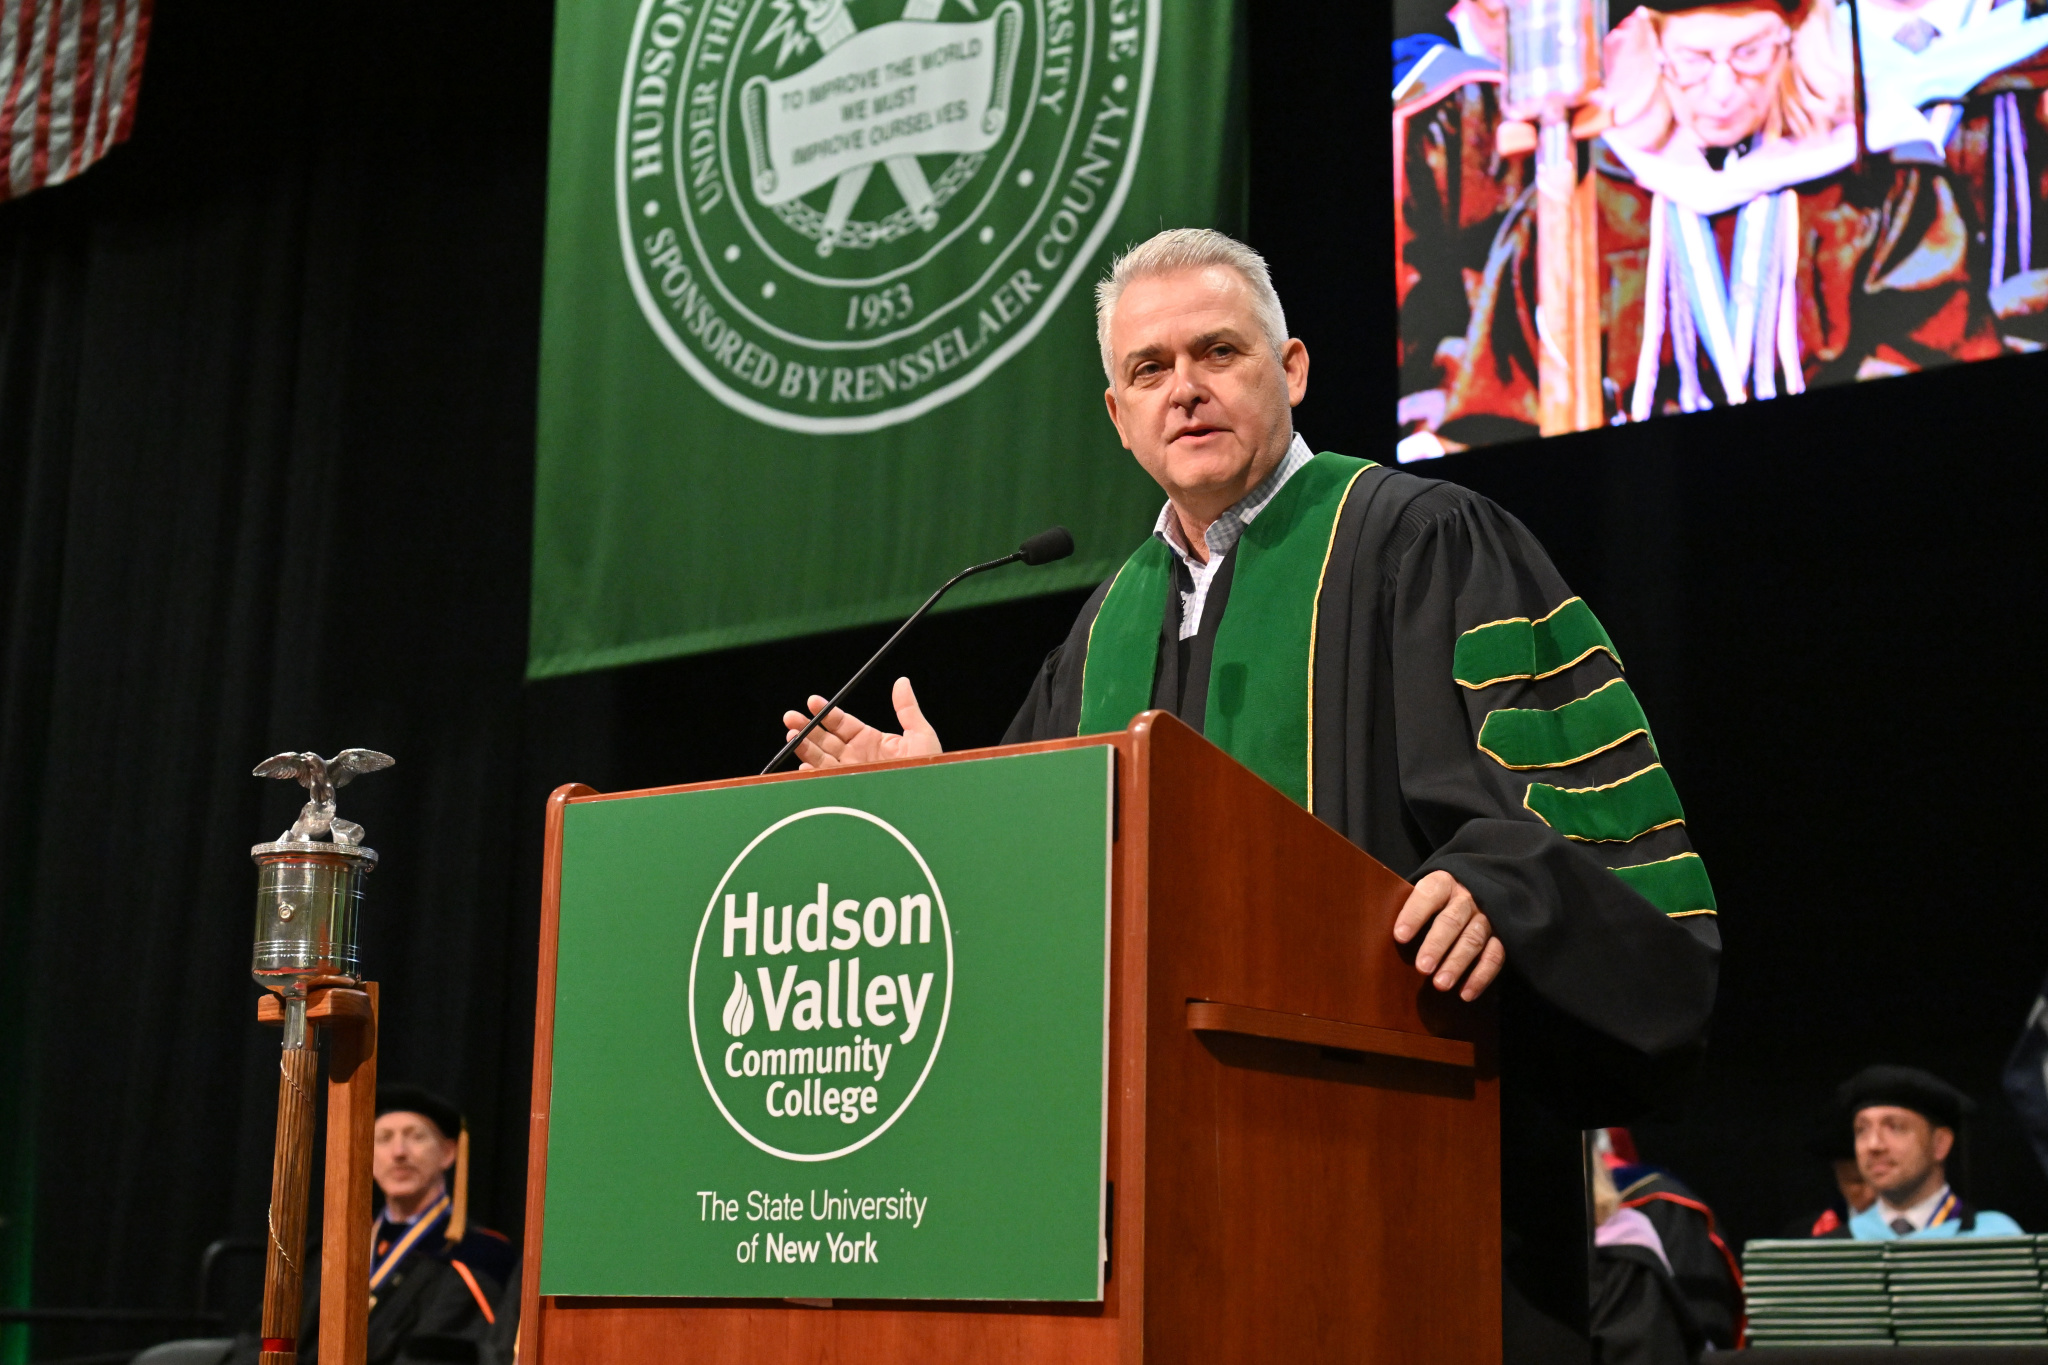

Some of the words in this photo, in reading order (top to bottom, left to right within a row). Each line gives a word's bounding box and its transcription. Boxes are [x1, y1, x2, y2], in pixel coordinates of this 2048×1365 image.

[781, 89, 803, 110] TO
[809, 68, 879, 104] IMPROVE
[885, 55, 916, 82] THE
[920, 37, 983, 71] WORLD
[842, 99, 867, 122] WE
[873, 84, 917, 114] MUST
[689, 79, 724, 215] UNDER
[793, 128, 863, 165] IMPROVE
[869, 99, 968, 146] OURSELVES
[643, 227, 778, 389] SPONSORED
[779, 361, 828, 402] BY
[830, 268, 1043, 403] RENSSELAER
[1035, 95, 1129, 270] COUNTY
[846, 283, 914, 330] 1953
[723, 883, 931, 957] Hudson
[757, 957, 934, 1044] Valley
[725, 1035, 892, 1081] Community
[766, 1078, 877, 1124] College
[697, 1191, 739, 1221] The
[746, 1190, 803, 1221] State
[810, 1188, 927, 1228] University
[736, 1233, 759, 1263] of
[766, 1233, 820, 1263] New
[826, 1232, 878, 1263] York
